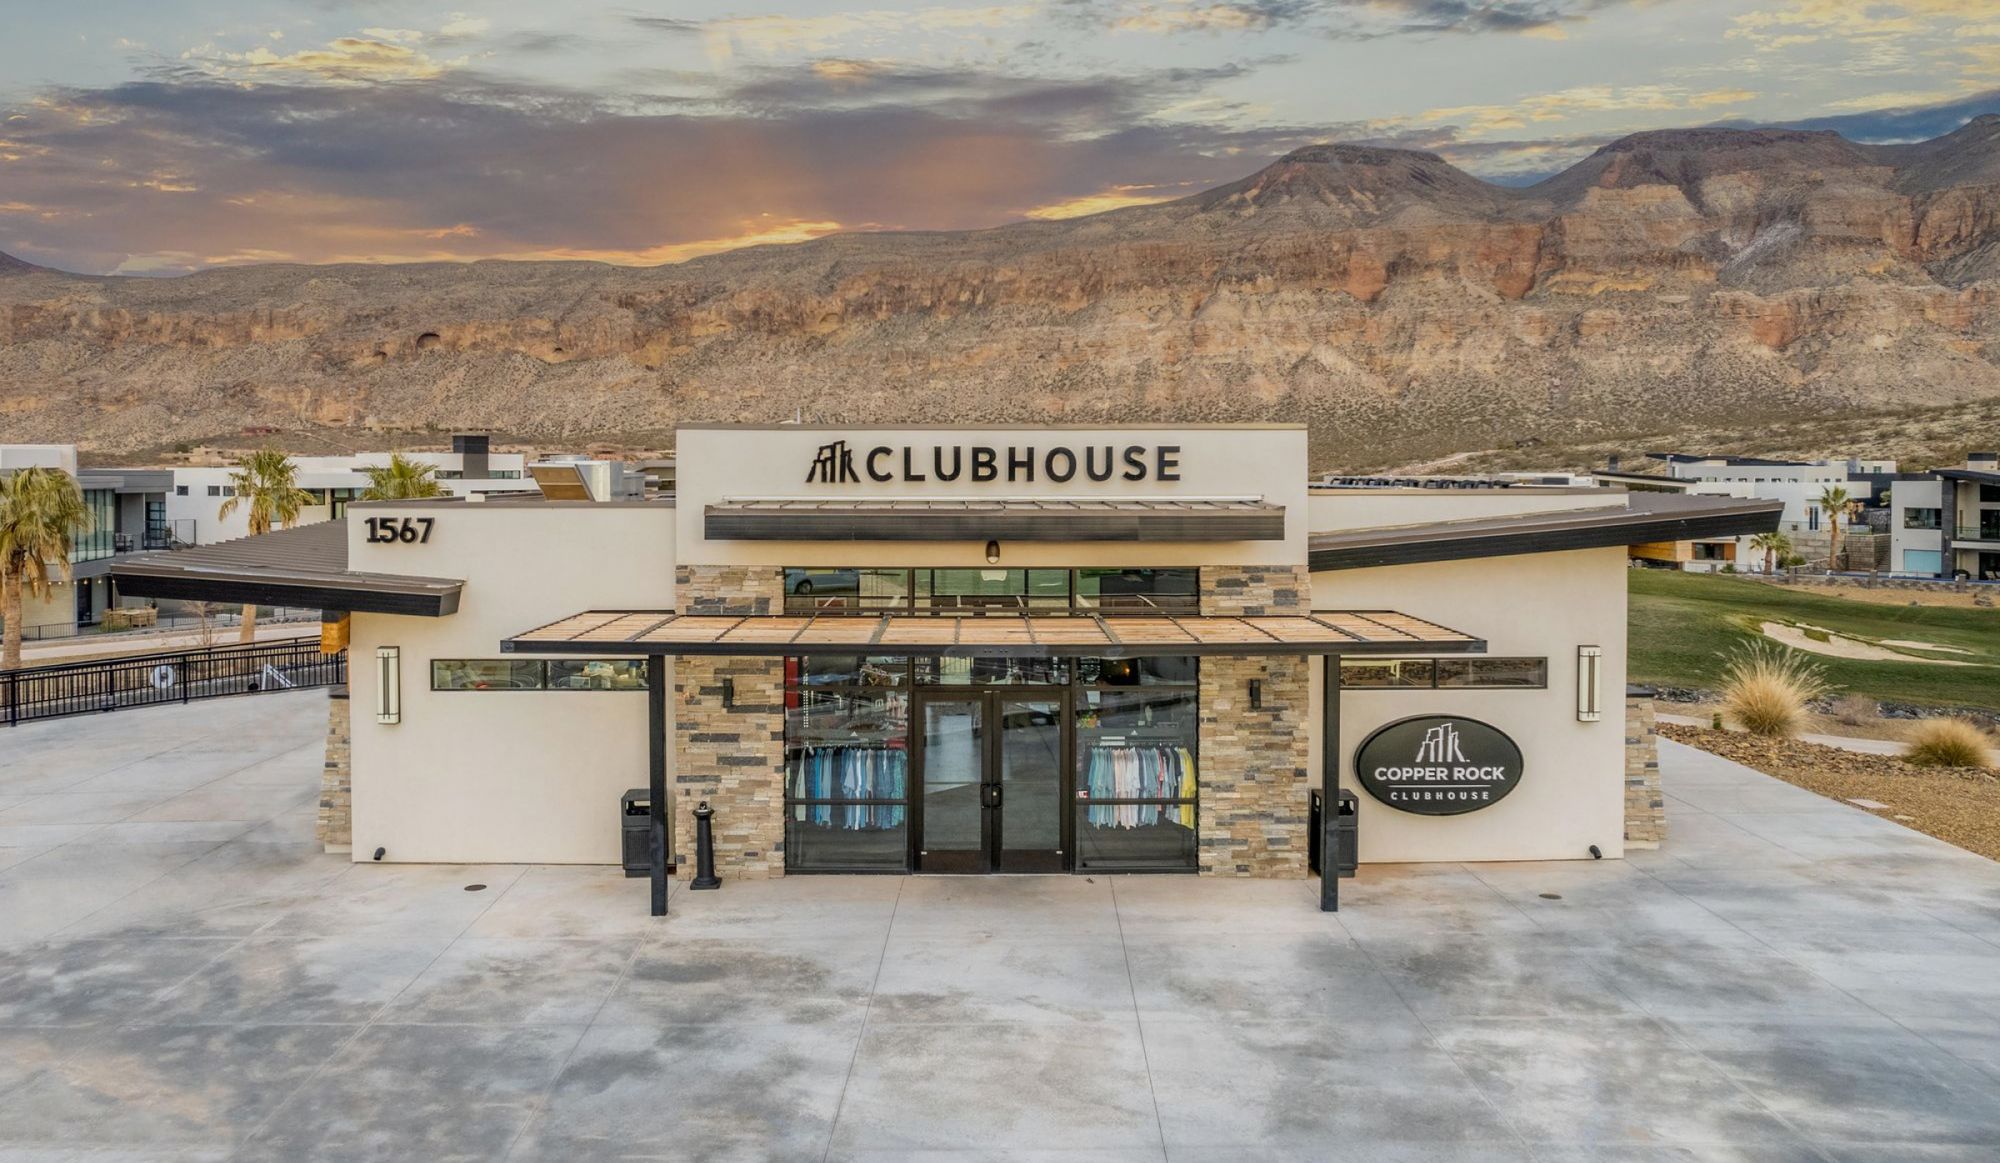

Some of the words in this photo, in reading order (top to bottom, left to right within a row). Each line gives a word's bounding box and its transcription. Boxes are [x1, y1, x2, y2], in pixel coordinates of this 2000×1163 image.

[865, 445, 1181, 483] CLUBHOUSE
[364, 516, 435, 544] 1567
[1374, 767, 1449, 781] COPPER
[1453, 766, 1505, 780] ROCK
[1390, 791, 1489, 801] CLUBHOUSE
